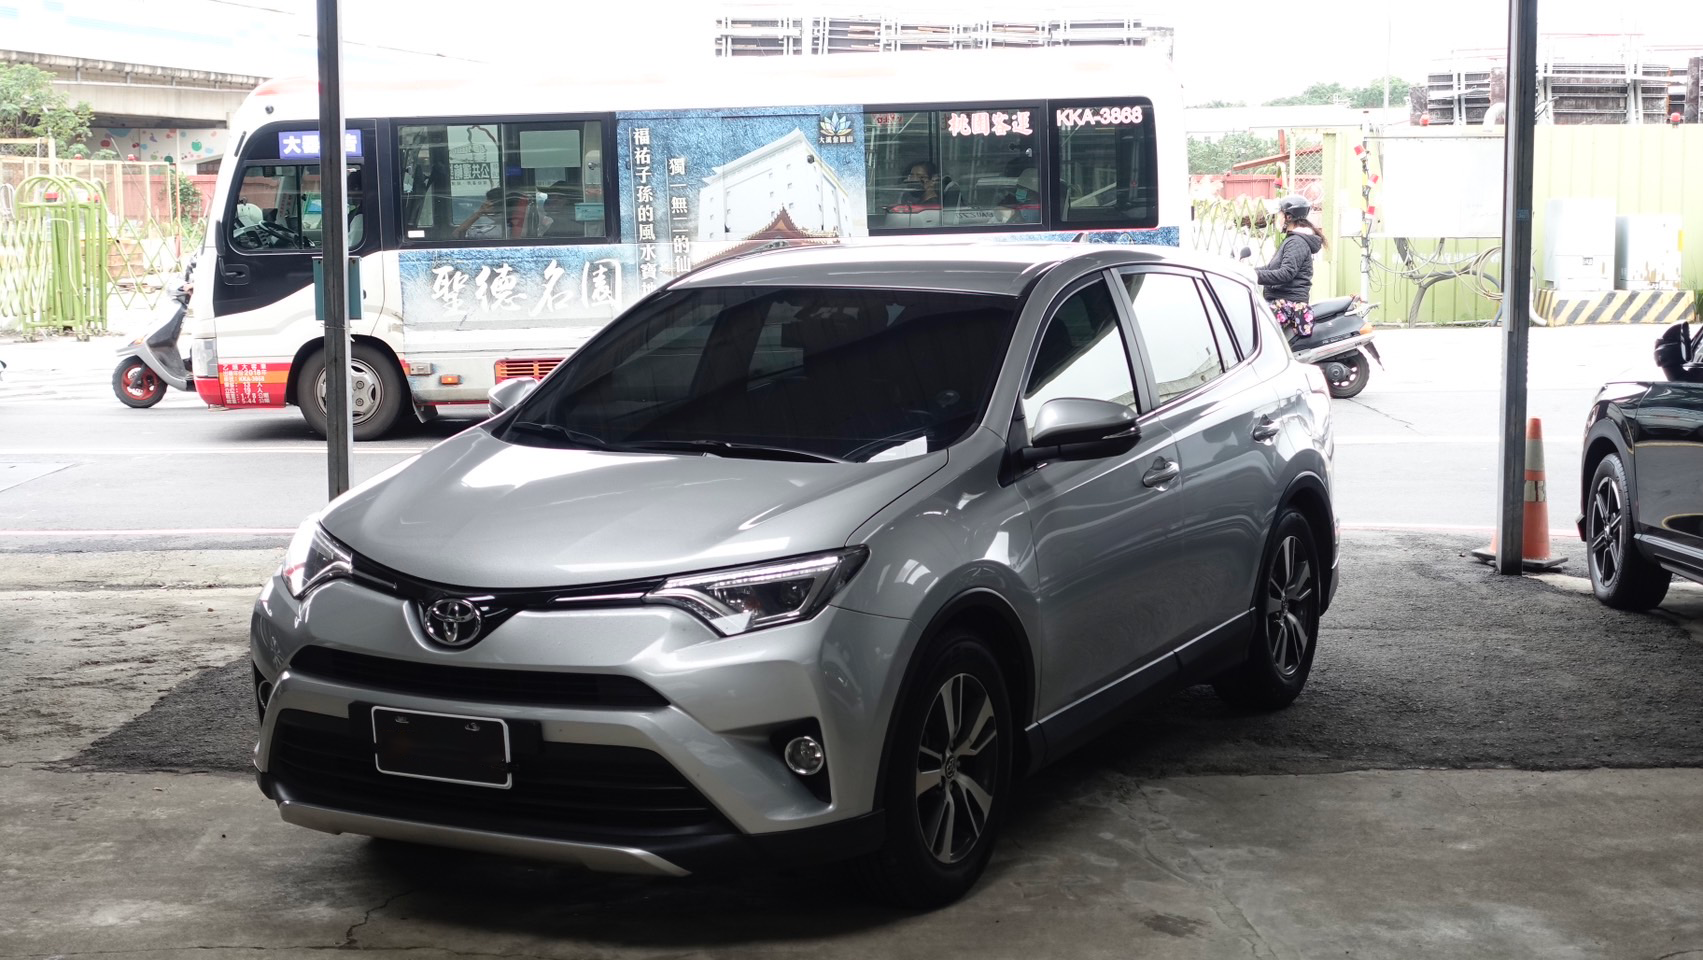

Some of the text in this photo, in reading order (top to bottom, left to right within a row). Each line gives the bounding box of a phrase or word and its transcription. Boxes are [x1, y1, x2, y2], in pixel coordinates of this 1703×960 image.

[947, 111, 1034, 137] 桃園客運
[1056, 105, 1143, 127] KKA-3868
[669, 157, 691, 277] 獨一無二的仙
[431, 258, 623, 317] 聖德名園
